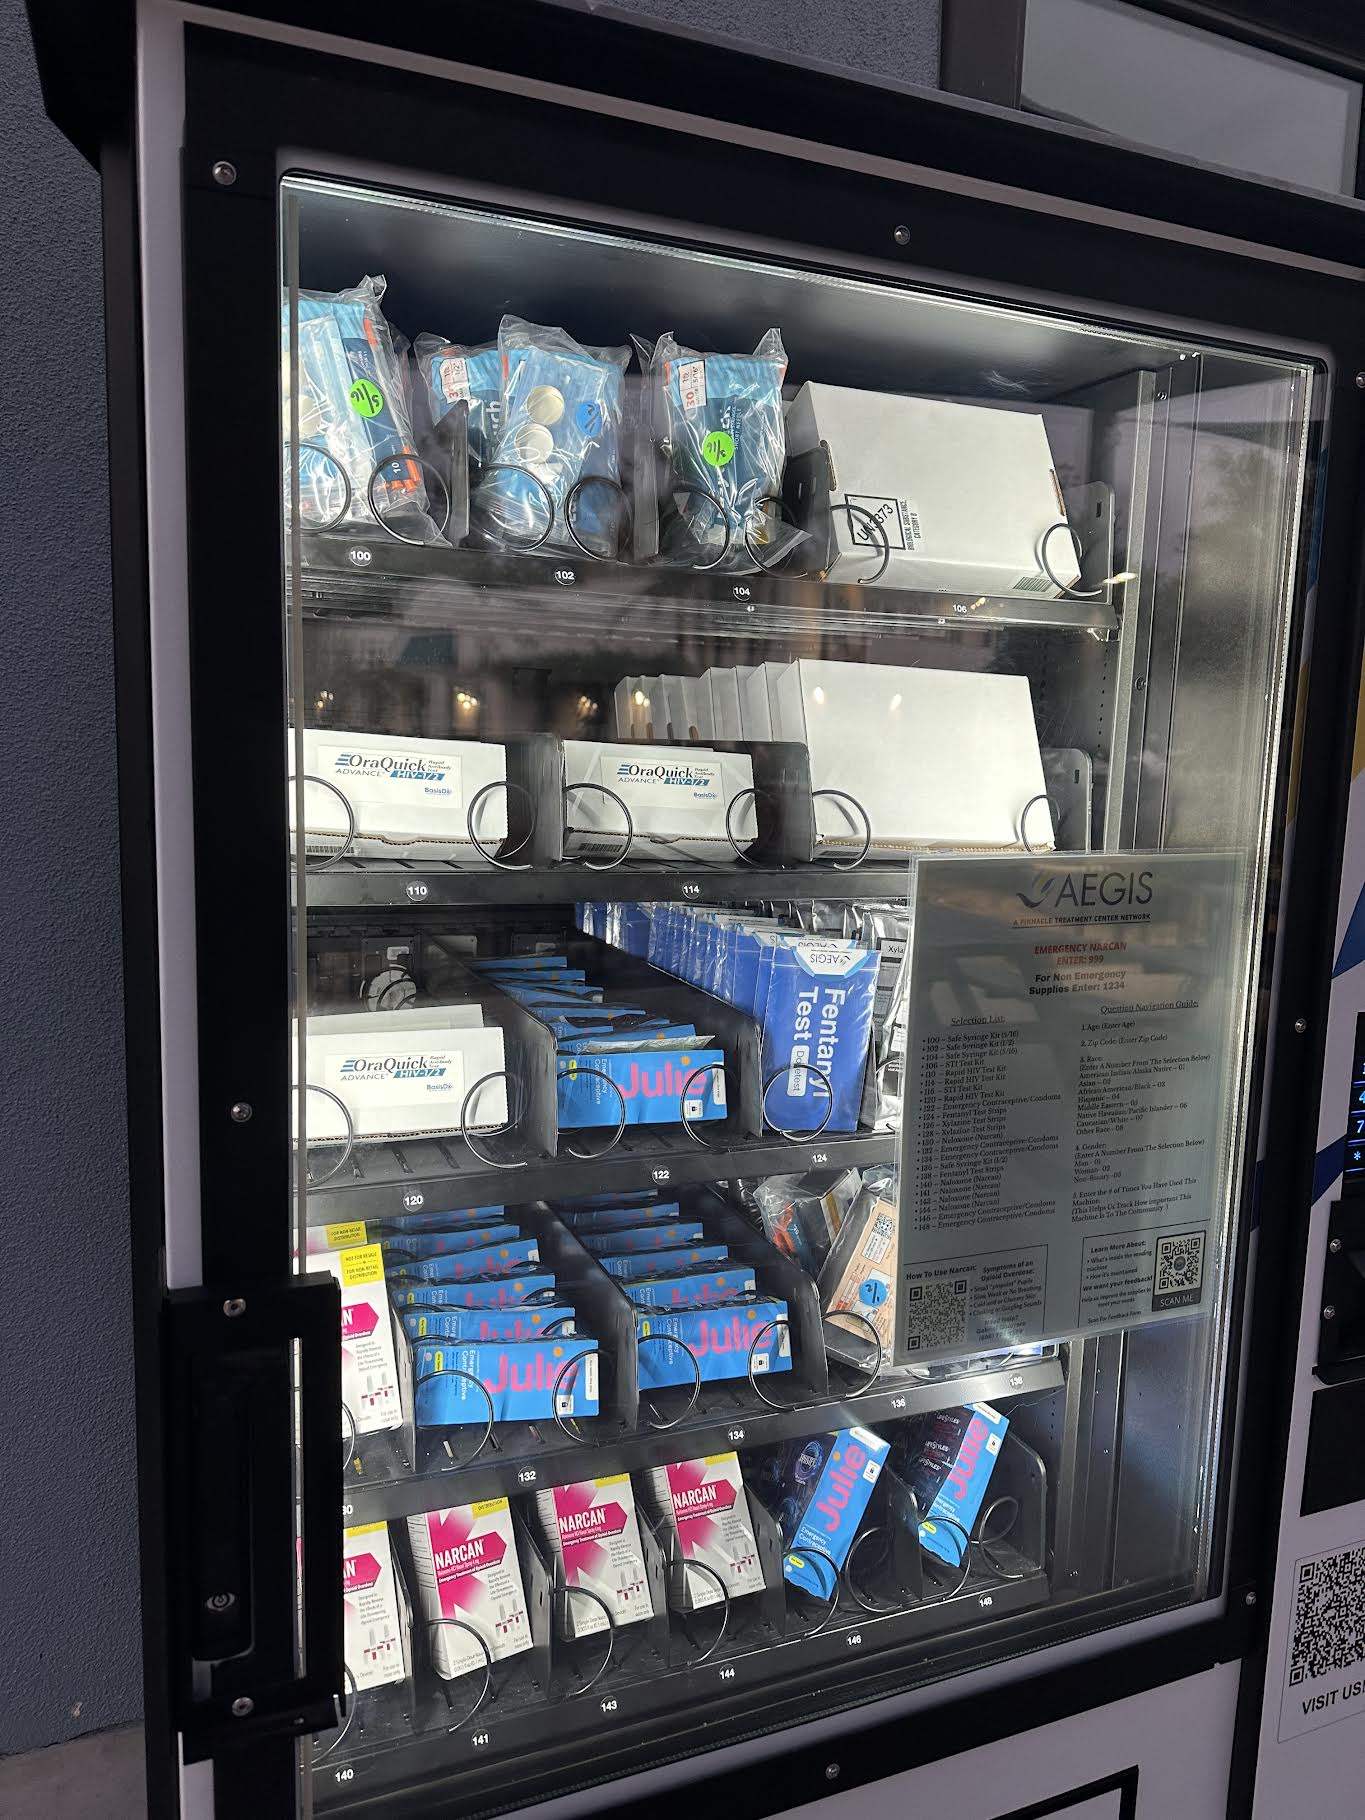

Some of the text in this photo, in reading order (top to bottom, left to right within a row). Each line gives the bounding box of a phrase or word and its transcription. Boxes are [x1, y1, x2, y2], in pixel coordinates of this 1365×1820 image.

[686, 391, 696, 408] 30
[392, 462, 401, 474] 10
[350, 550, 371, 561] 100
[556, 570, 575, 580] 102
[733, 587, 751, 596] 104
[952, 604, 967, 614] 106
[350, 754, 426, 773] OraQuick
[335, 768, 382, 777] ADVANCE
[397, 770, 439, 781] HIV-1/2
[628, 765, 694, 780] OraQuick
[669, 778, 705, 786] HIV-1/2
[407, 886, 427, 895] 110
[683, 885, 700, 894] 114
[1054, 871, 1153, 908] AEGIS
[1020, 917, 1052, 925] PINNACLE
[1055, 916, 1092, 924] TREATMENT
[1093, 914, 1119, 922] CENTER
[1120, 913, 1151, 921] NETWORK
[1034, 941, 1127, 955] EMERGENCY NARCAN
[1056, 954, 1105, 965] ENTER: 999
[1035, 970, 1126, 982] For Non Emergency
[1028, 981, 1125, 996] Supplies Enter: 1234
[1100, 1004, 1134, 1015] Question
[1135, 1002, 1174, 1012] Navigation
[951, 1017, 987, 1025] Selection
[791, 985, 818, 1092] Test Doetest
[812, 987, 845, 1097] Fentanyl
[947, 1035, 962, 1043] Safe
[963, 1033, 989, 1042] Syringe
[1087, 1039, 1099, 1048] Zip
[946, 1044, 962, 1052] Safe
[961, 1042, 988, 1051] Syringe
[988, 1040, 999, 1048] Kit
[945, 1052, 961, 1060] Safe
[961, 1050, 987, 1059] Syringe
[1132, 1059, 1149, 1067] From
[1162, 1055, 1190, 1064] Selection
[353, 1056, 428, 1073] OraQuick
[925, 1062, 938, 1070] 106
[945, 1060, 958, 1069] STI
[959, 1059, 974, 1067] Test
[340, 1068, 443, 1082] ADVANCE HIV-1/2
[618, 1056, 707, 1099] Julie
[925, 1071, 937, 1079] 110
[944, 1069, 965, 1078] Rapid
[966, 1067, 981, 1075] HIV
[923, 1106, 1007, 1121] 124 Fentanyl Test Strips
[942, 1103, 981, 1112] Emergency
[1356, 1119, 1365, 1134] 7
[812, 1154, 827, 1163] 124
[653, 1170, 670, 1180] 122
[404, 1195, 423, 1206] 120
[906, 1265, 977, 1280] How To Use Narcan:
[982, 1263, 1016, 1273] Symptoms
[349, 1270, 378, 1280] DISTRIBUTION
[1160, 1293, 1194, 1307] SCAN ME
[688, 1311, 772, 1356] Julie
[484, 1348, 579, 1394] Julie
[1009, 1377, 1024, 1385] 138
[728, 1430, 745, 1440] 134
[950, 1417, 989, 1500] Julie
[519, 1471, 537, 1482] 132
[816, 1445, 866, 1532] Julie
[673, 1485, 717, 1510] NARCAN
[558, 1507, 606, 1533] NARCAN
[799, 1526, 827, 1545] Emergency
[434, 1539, 484, 1570] NARCAN
[979, 1597, 993, 1606] 148
[847, 1635, 862, 1644] 146
[720, 1669, 735, 1679] 144
[601, 1701, 617, 1711] 143
[1302, 1689, 1339, 1715] VISIT
[472, 1734, 489, 1745] 141
[335, 1769, 354, 1781] 140
